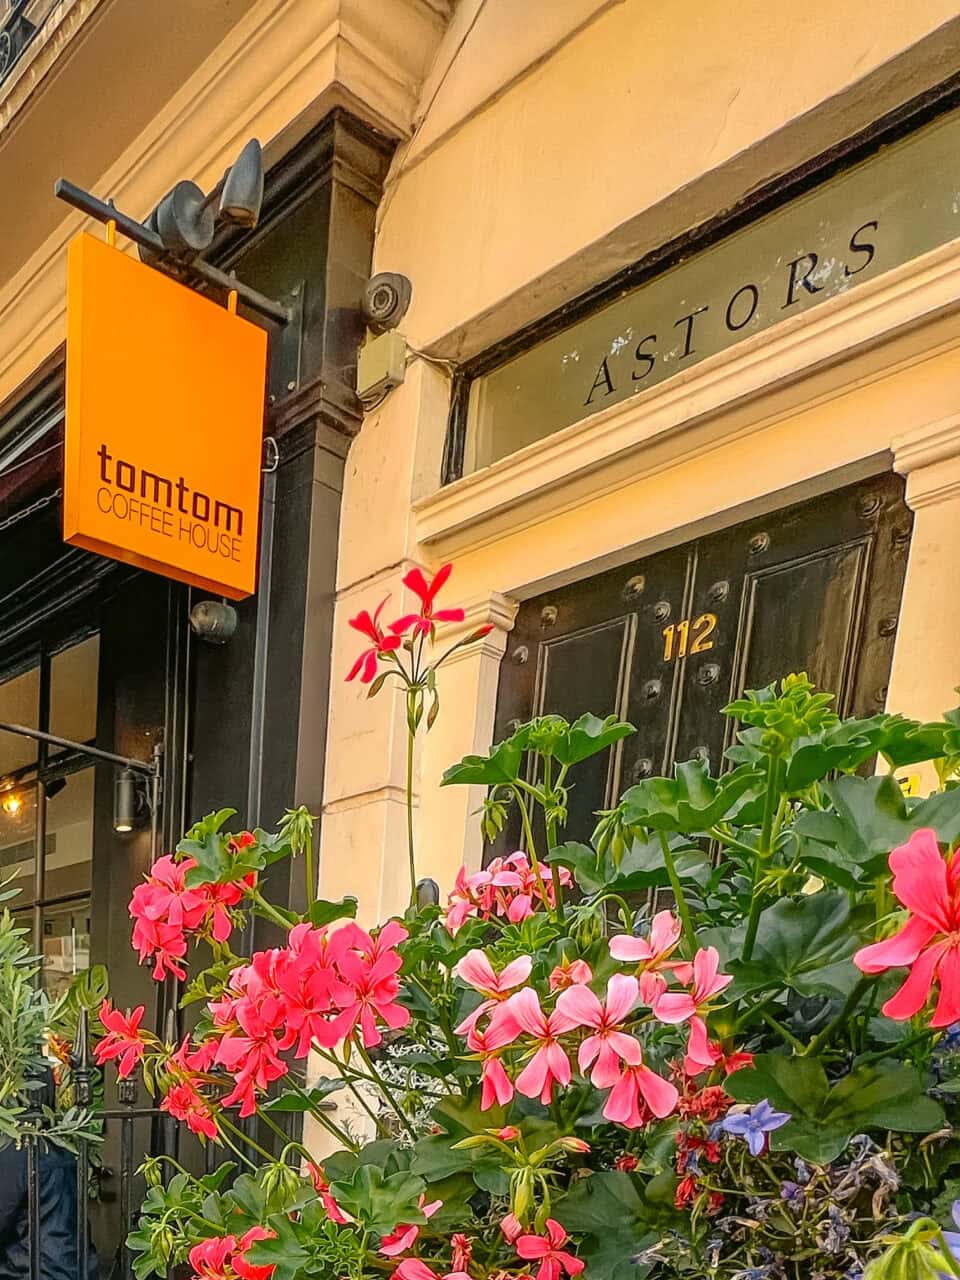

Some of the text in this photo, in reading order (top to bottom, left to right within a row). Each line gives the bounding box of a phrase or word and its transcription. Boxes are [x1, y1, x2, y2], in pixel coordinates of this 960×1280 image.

[583, 220, 879, 406] ASTORS
[96, 487, 242, 562] COFFEE HOUSE
[97, 444, 243, 536] tomtom
[663, 612, 717, 662] 112
